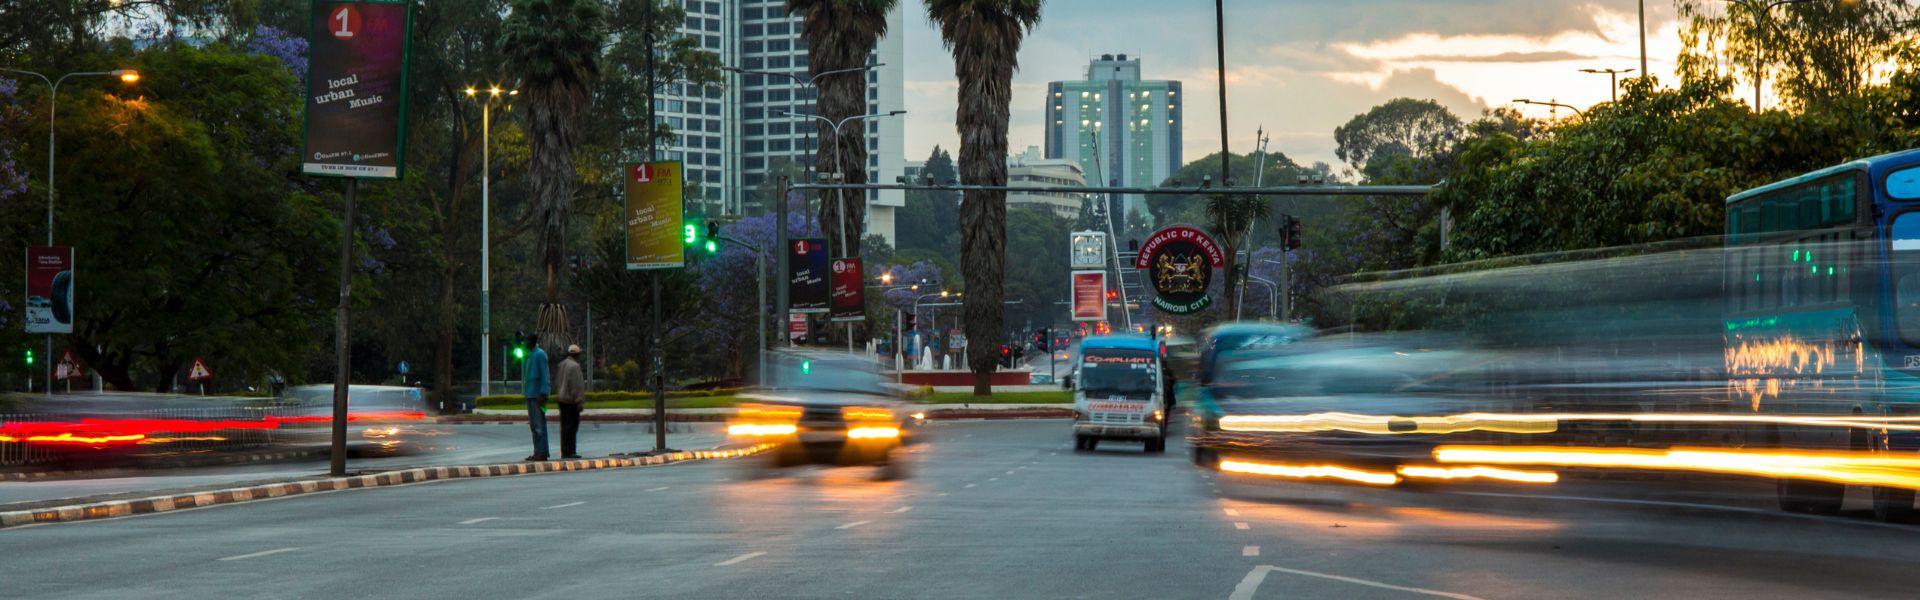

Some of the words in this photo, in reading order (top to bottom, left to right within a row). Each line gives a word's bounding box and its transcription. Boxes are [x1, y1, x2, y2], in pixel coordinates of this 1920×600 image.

[335, 8, 353, 36] 1
[328, 74, 358, 89] local
[315, 89, 354, 104] urban
[349, 95, 383, 109] Music
[637, 163, 650, 182] 1
[657, 168, 672, 177] FM
[636, 205, 655, 215] local
[629, 214, 654, 226] urban
[651, 217, 672, 227] Music
[797, 240, 807, 254] 1
[1141, 231, 1178, 266] REPUBLIC
[1181, 230, 1194, 238] OF
[1196, 235, 1220, 265] KENYA
[792, 275, 809, 284] urban
[796, 269, 811, 277] local
[1153, 295, 1188, 312] NAIROBI
[1190, 294, 1209, 311] CITY
